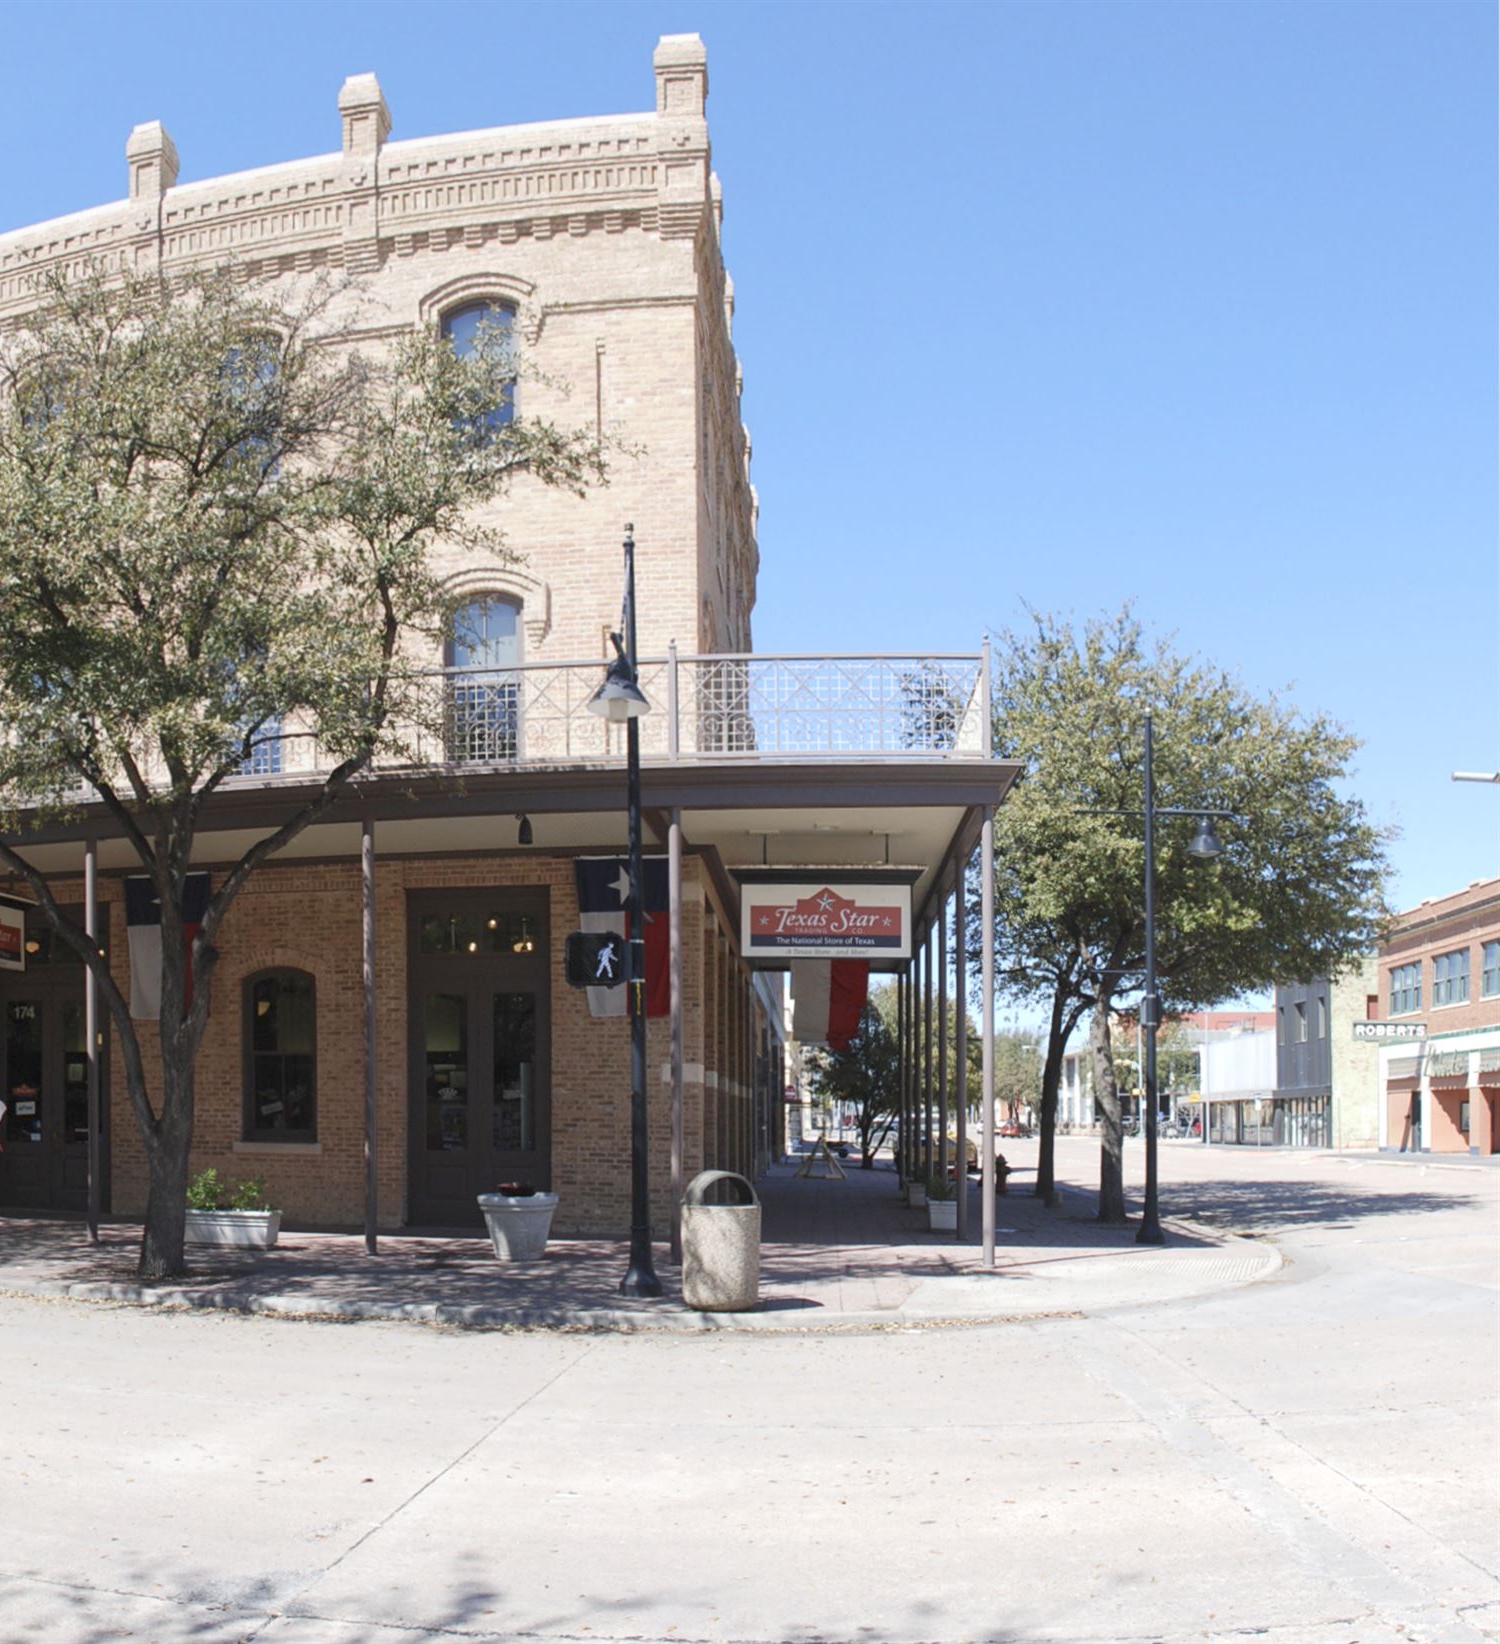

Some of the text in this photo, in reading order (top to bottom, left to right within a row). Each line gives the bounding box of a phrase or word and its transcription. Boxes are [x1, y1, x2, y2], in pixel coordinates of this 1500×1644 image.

[775, 906, 879, 933] Texas Star
[776, 936, 875, 945] The National Store of Texas
[14, 1006, 36, 1020] 174
[1355, 1024, 1425, 1036] ROBERTS
